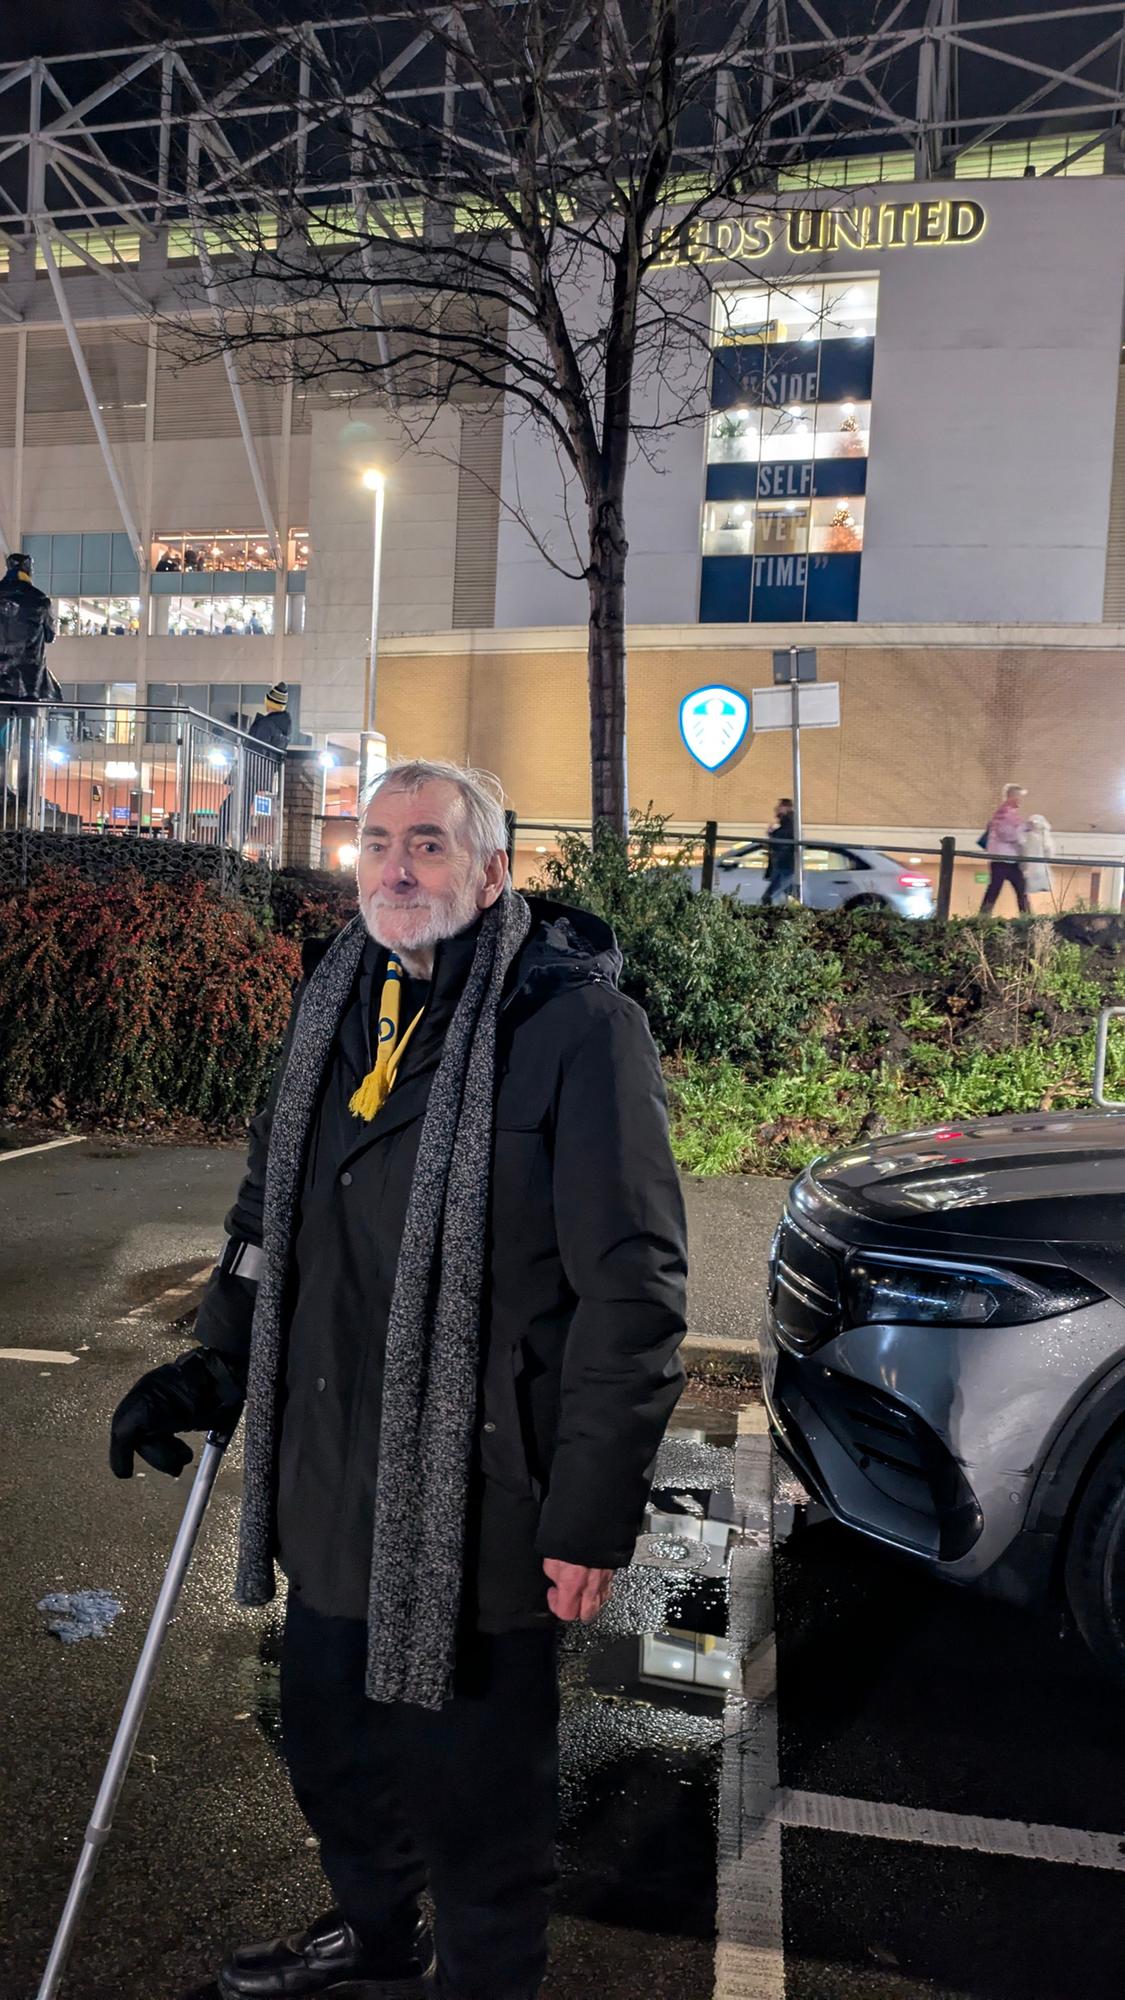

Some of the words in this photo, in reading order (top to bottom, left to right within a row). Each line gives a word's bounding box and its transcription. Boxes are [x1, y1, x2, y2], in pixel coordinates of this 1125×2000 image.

[644, 213, 775, 270] EEDS
[787, 199, 986, 255] UNITED
[758, 464, 818, 496] SELF,
